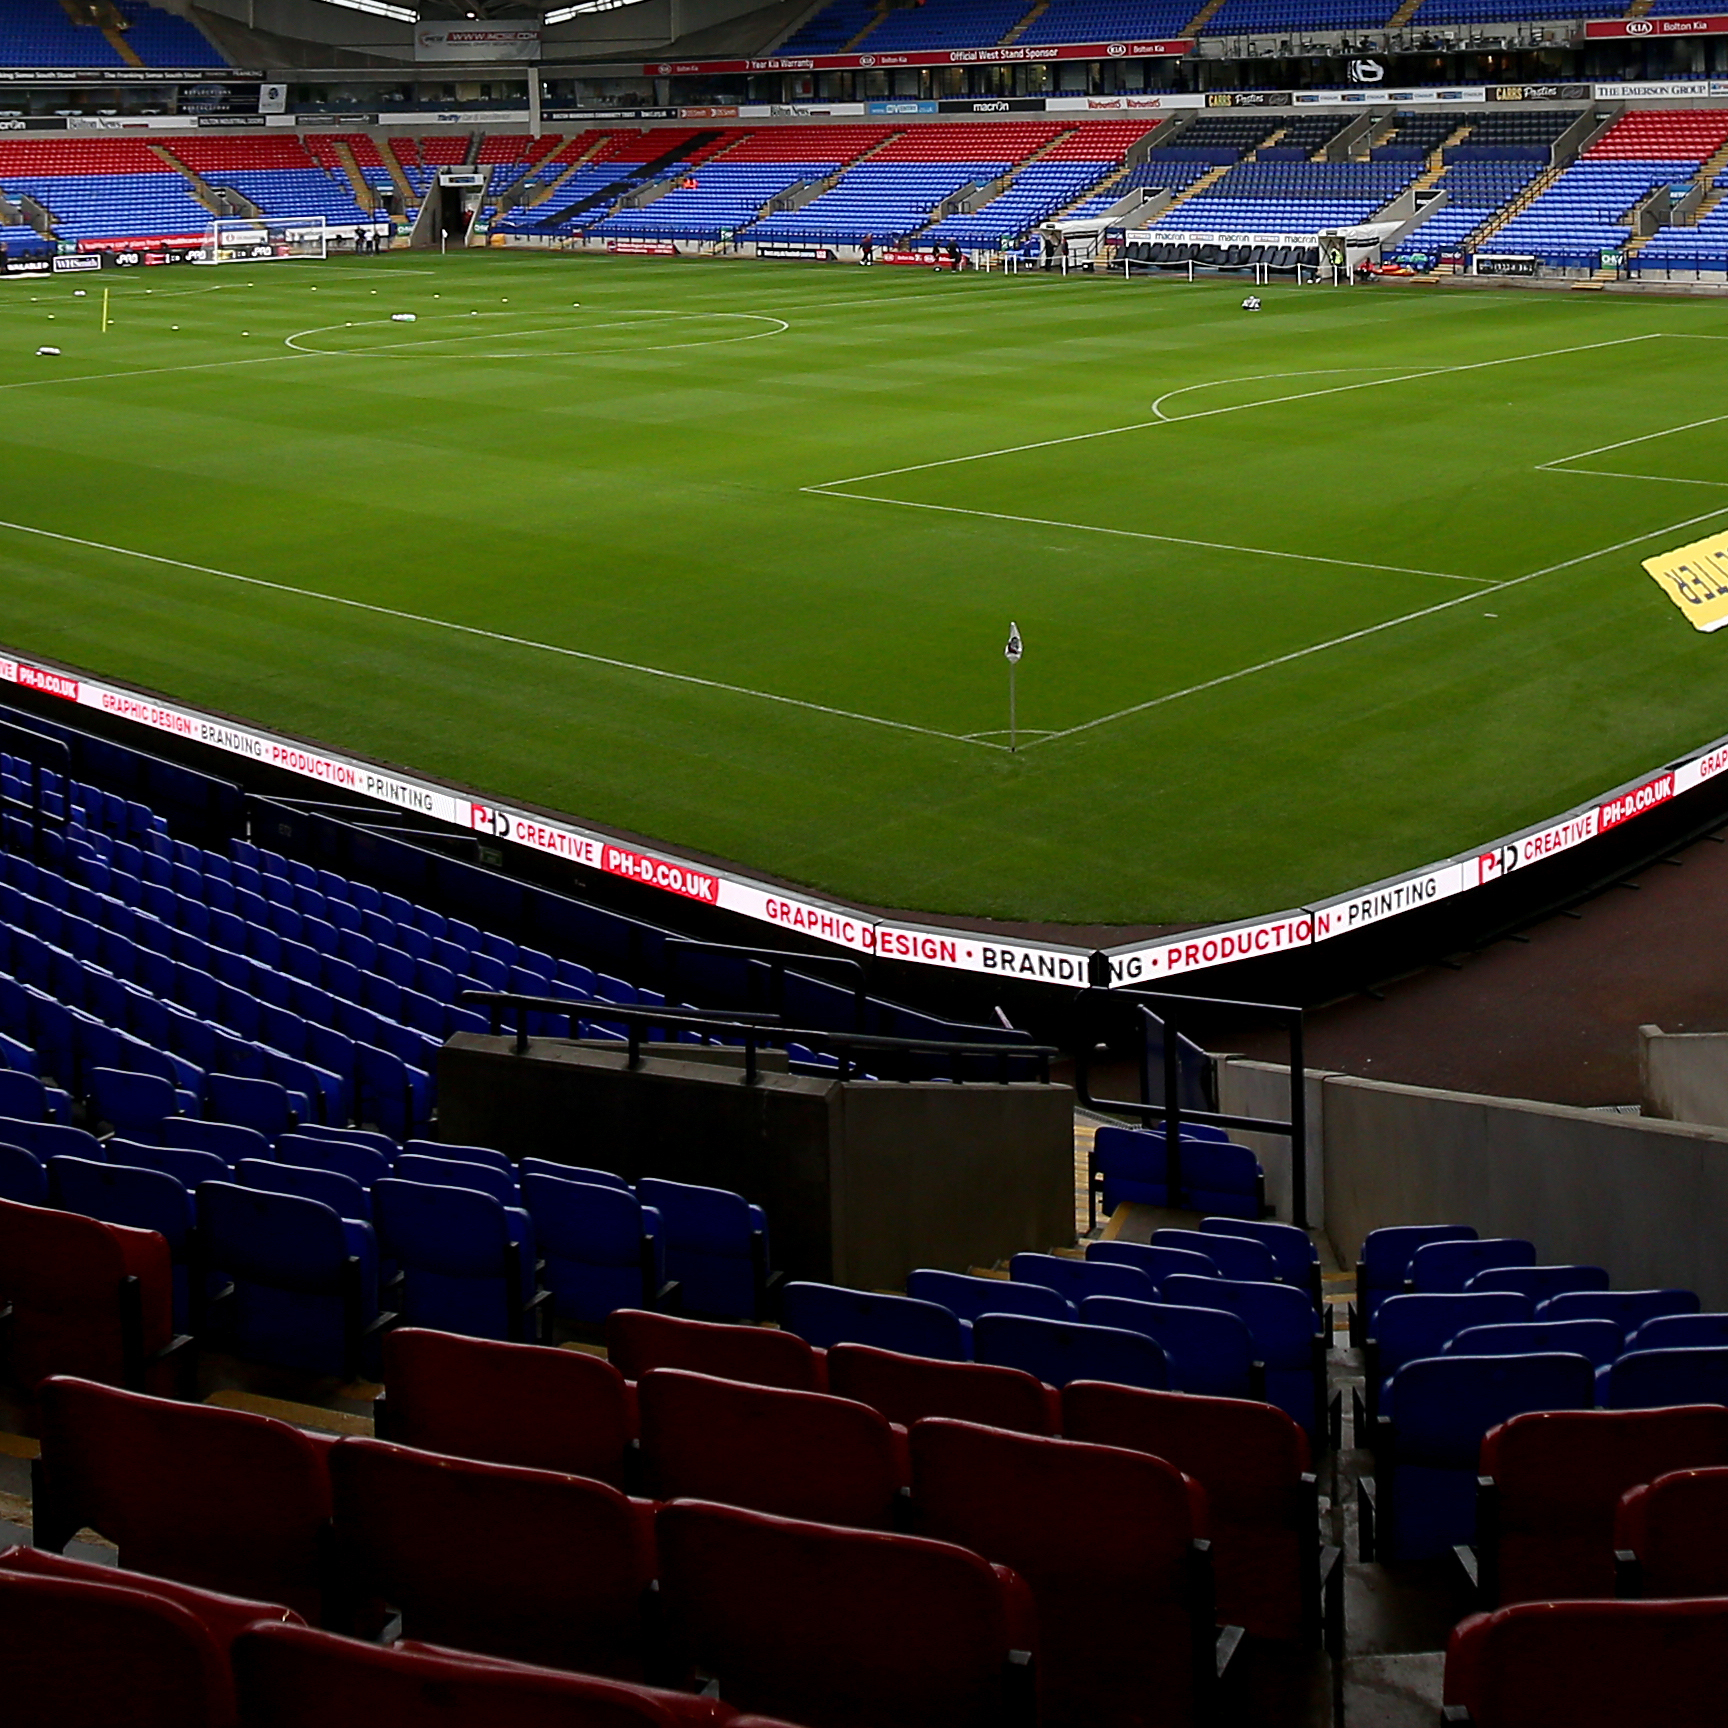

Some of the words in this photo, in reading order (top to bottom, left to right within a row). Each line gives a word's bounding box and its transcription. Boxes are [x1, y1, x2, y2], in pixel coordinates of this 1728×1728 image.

[1663, 22, 1692, 32] Bolton
[1693, 21, 1708, 31] Kia
[950, 51, 978, 62] Official
[978, 51, 1000, 61] West
[1000, 49, 1024, 60] Stand
[1025, 48, 1059, 60] Sponsor
[973, 101, 1010, 112] macron
[1598, 87, 1620, 96] THE
[1622, 86, 1669, 95] EMERSON
[1672, 85, 1706, 94] GROUP
[20, 666, 78, 697] PH-D.CO.UK
[102, 694, 149, 721] GRAPHIC
[151, 708, 191, 735] DESIGN
[201, 724, 262, 757] BRANDING
[273, 746, 356, 786] PRODUCTION
[367, 776, 434, 811] PRINTING
[1602, 776, 1673, 828] PH-D.CO.UK
[516, 822, 593, 863] CREATIVE
[1524, 814, 1592, 861] CREATIVE
[609, 850, 714, 901] PH-D.CO.UK
[766, 898, 856, 943] GRAPHIC
[862, 927, 957, 964] DESIGN
[983, 947, 1143, 983] BRANDING
[1168, 913, 1331, 970] PRODUCTION
[1348, 877, 1437, 926] PRINTING
